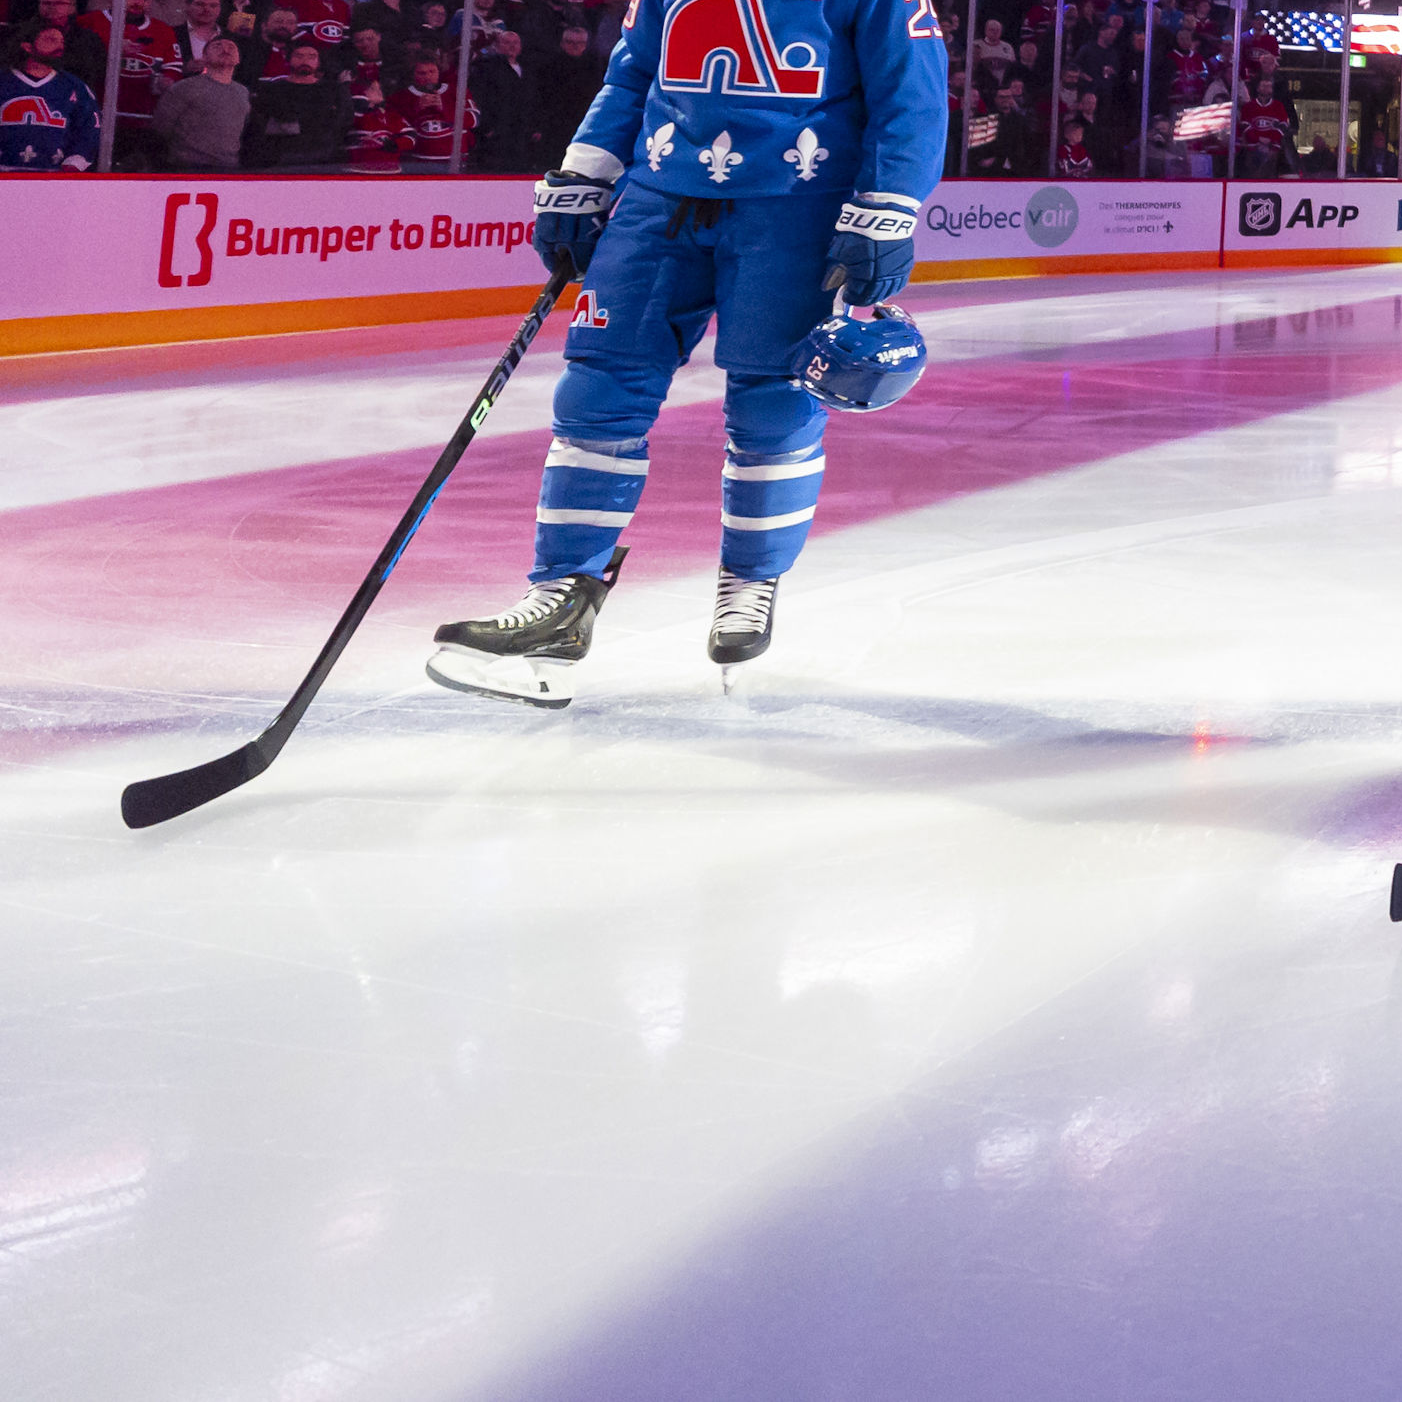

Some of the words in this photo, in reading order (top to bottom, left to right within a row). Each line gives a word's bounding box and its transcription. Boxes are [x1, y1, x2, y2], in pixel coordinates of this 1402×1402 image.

[534, 191, 604, 209] UER
[926, 205, 1022, 237] Québec
[1028, 203, 1073, 228] vair
[226, 216, 381, 262] Bumper
[389, 218, 425, 251] to
[806, 355, 830, 382] 29
